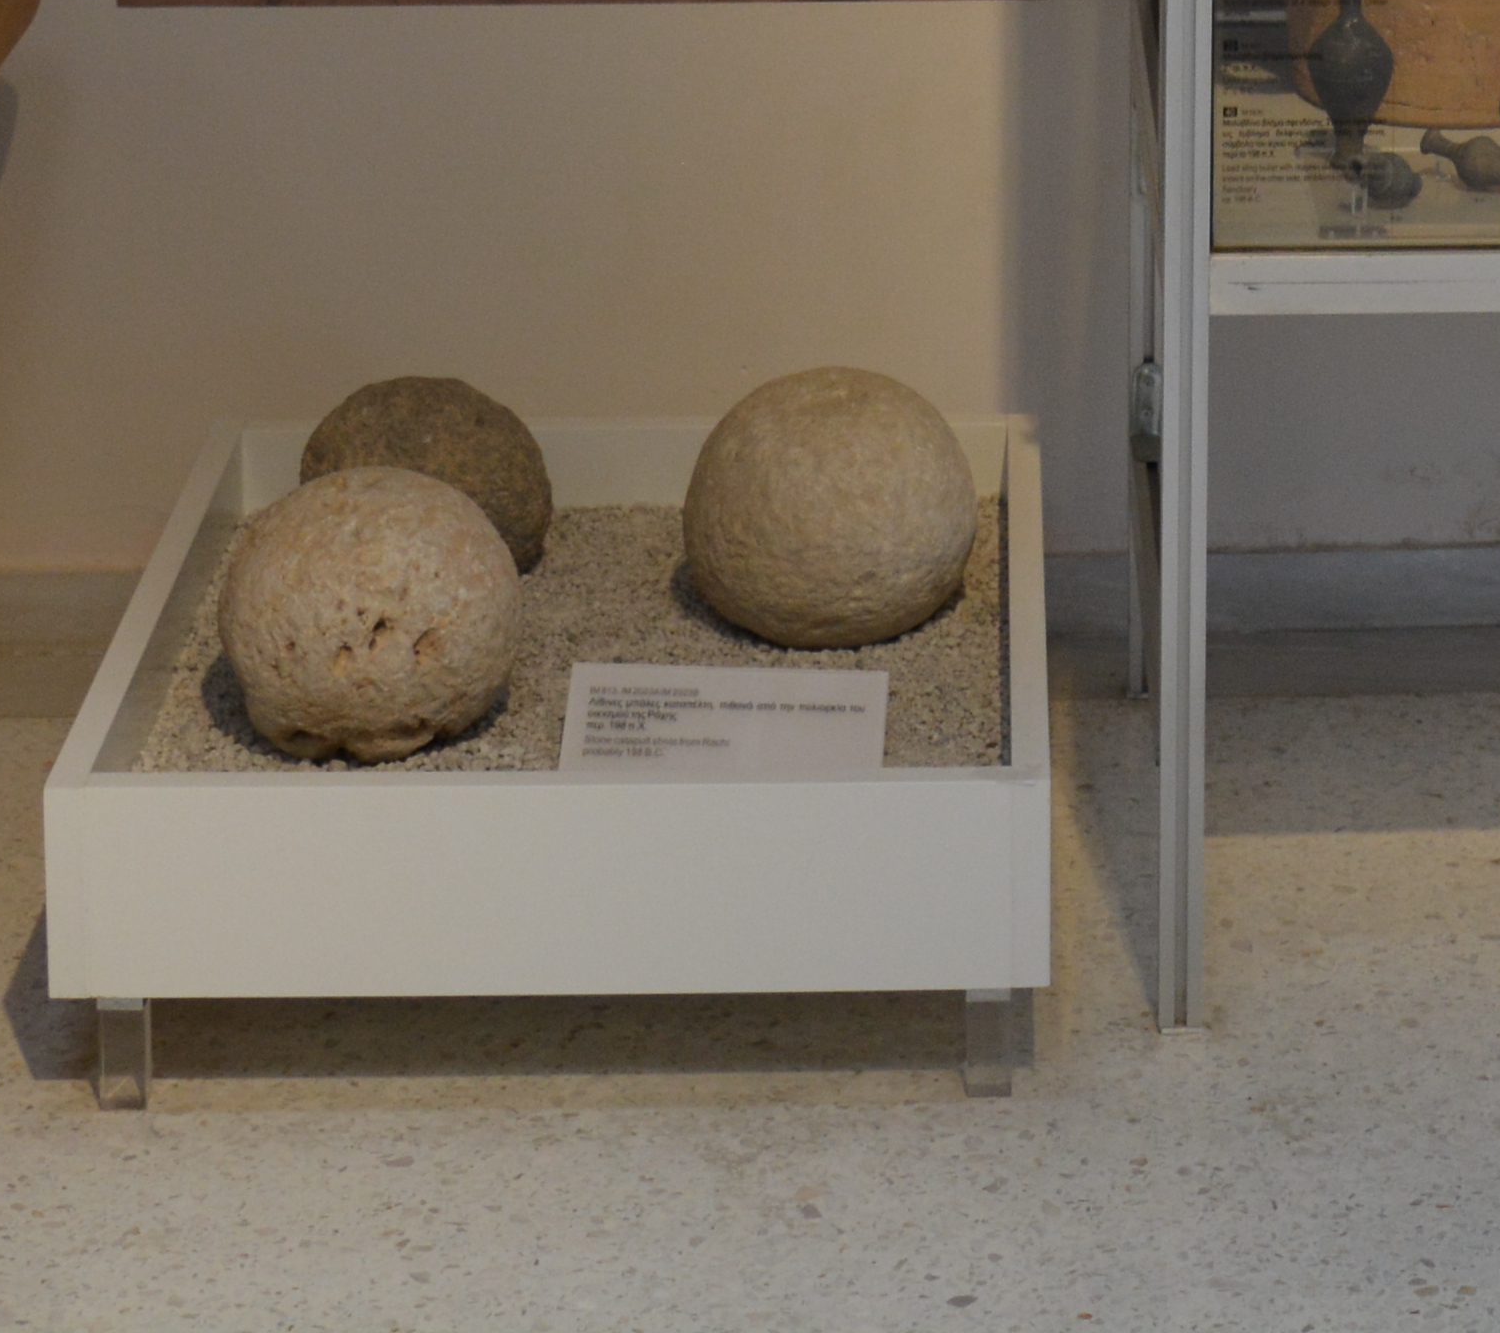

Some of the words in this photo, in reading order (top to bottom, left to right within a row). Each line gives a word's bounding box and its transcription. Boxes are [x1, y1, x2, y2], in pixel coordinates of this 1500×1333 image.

[584, 734, 611, 746] Stone
[679, 737, 701, 747] from
[582, 746, 623, 758] probably
